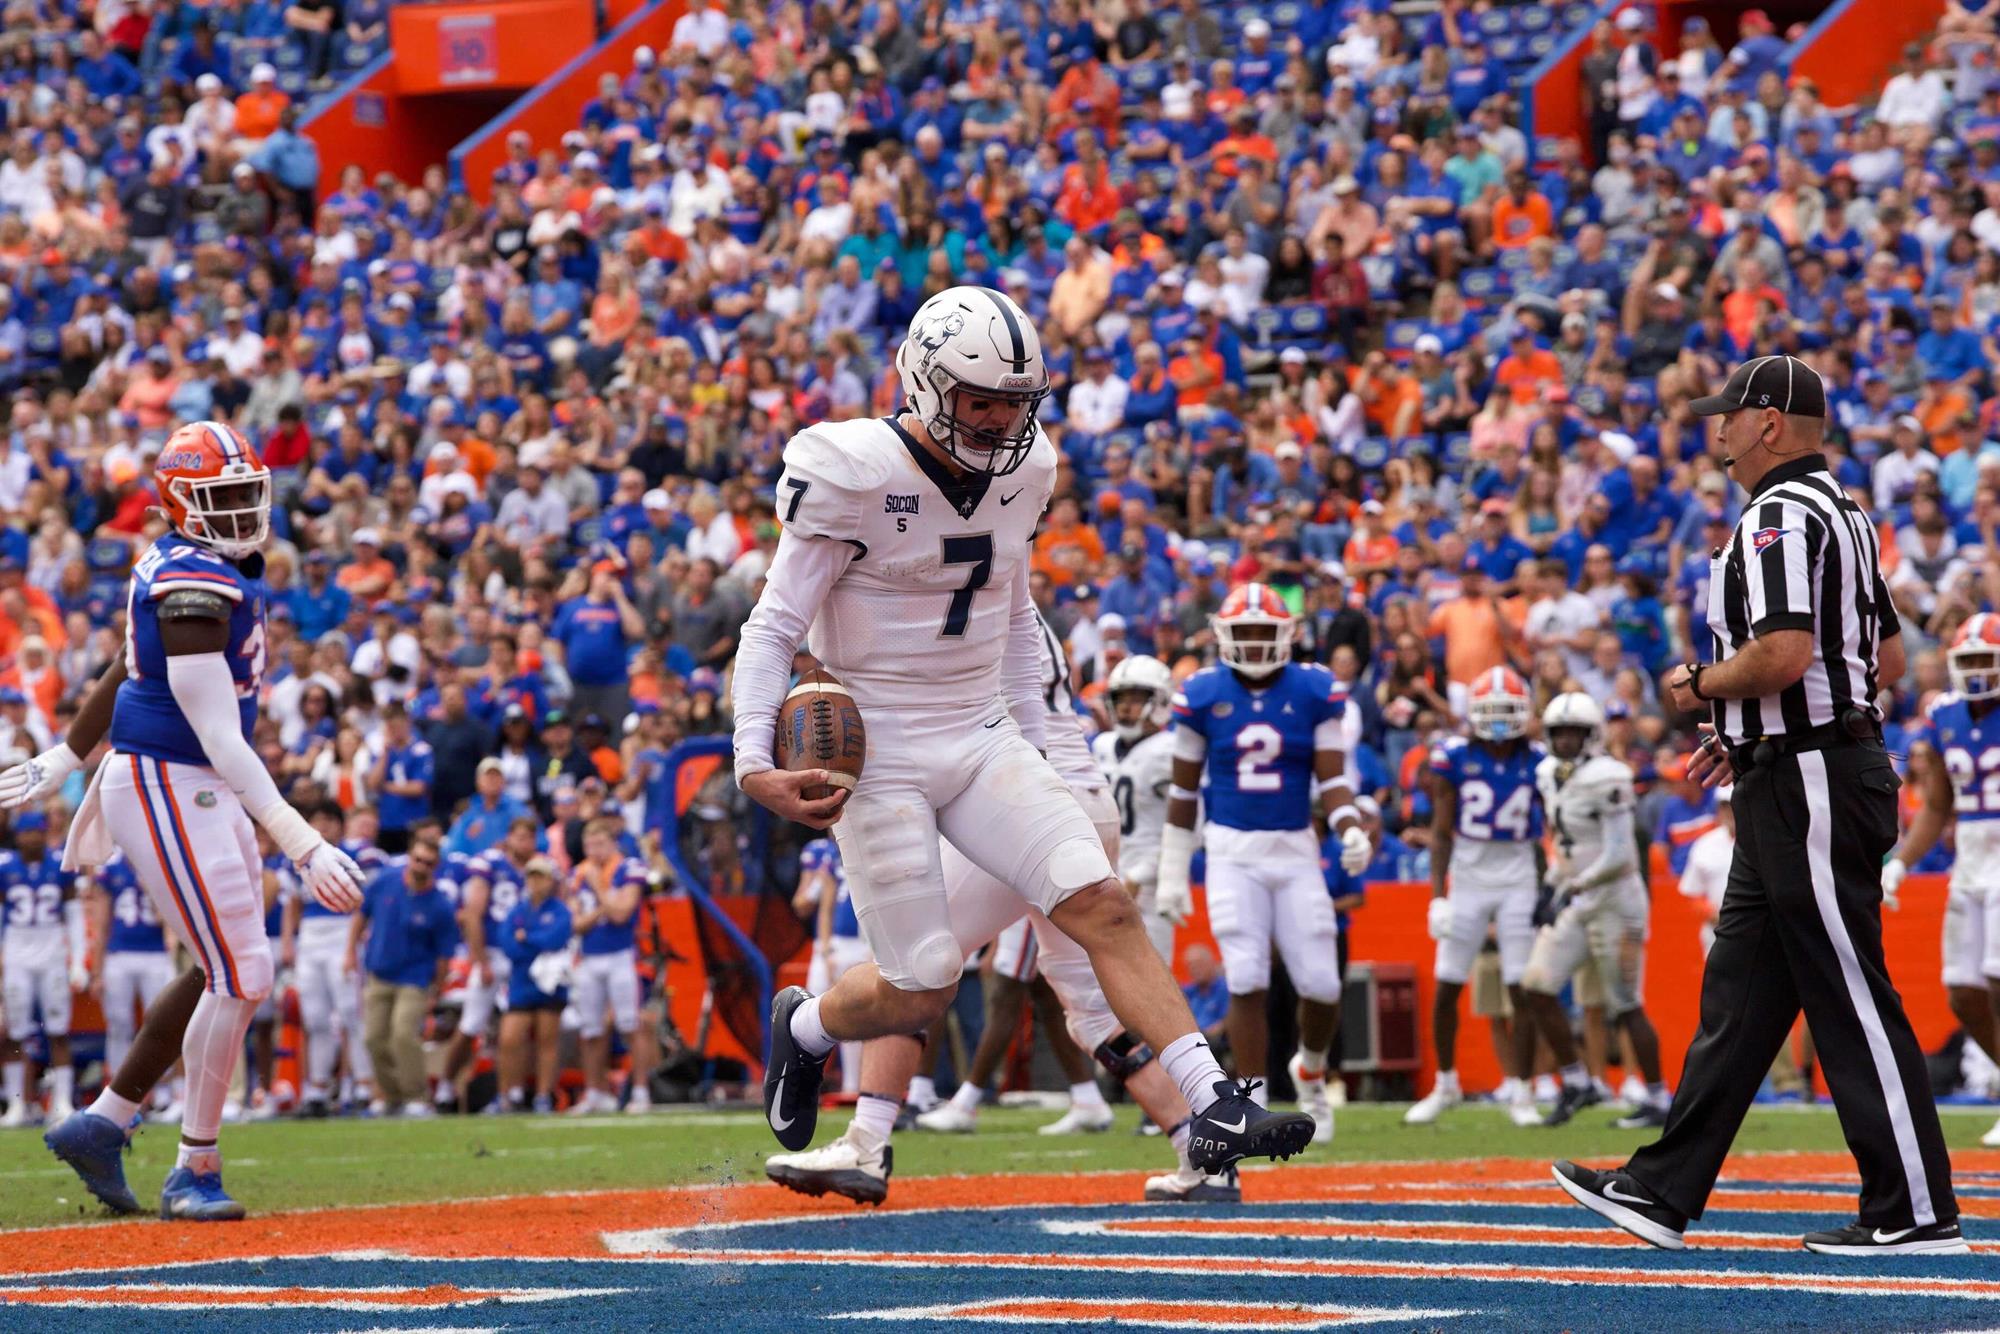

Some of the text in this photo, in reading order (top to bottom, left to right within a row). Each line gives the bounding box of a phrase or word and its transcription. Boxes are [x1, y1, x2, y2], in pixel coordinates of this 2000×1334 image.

[1005, 377, 1032, 388] DOGS
[1759, 394, 1770, 406] S
[784, 476, 812, 524] 7
[884, 493, 920, 515] SOCON
[896, 518, 908, 533] 5
[936, 529, 996, 641] 7
[1235, 722, 1283, 792] 2
[1459, 779, 1534, 841] 24
[6, 883, 62, 925] 32
